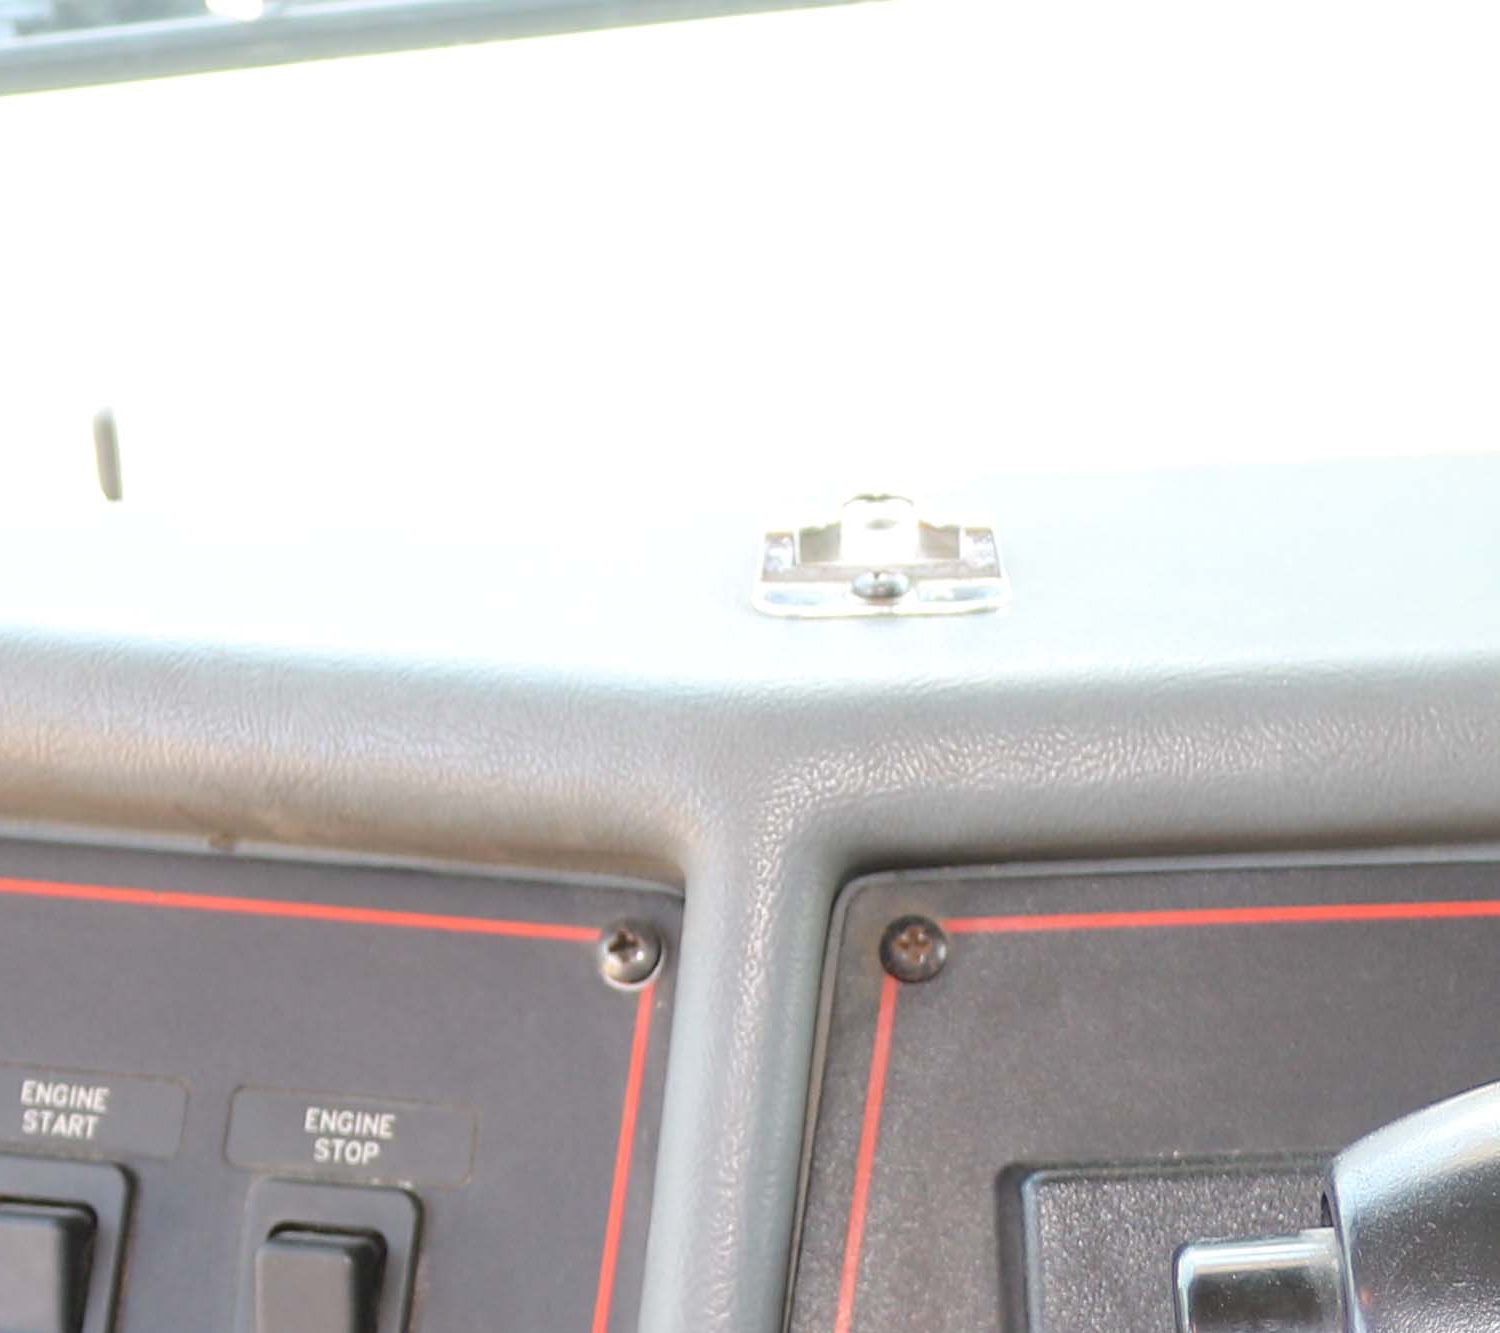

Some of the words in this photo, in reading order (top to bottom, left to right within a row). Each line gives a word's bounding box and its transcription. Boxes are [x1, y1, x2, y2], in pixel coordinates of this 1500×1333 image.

[20, 1079, 110, 1114] ENGINE
[22, 1110, 99, 1140] START
[304, 1106, 396, 1141] ENGINE
[313, 1138, 381, 1166] STOP
